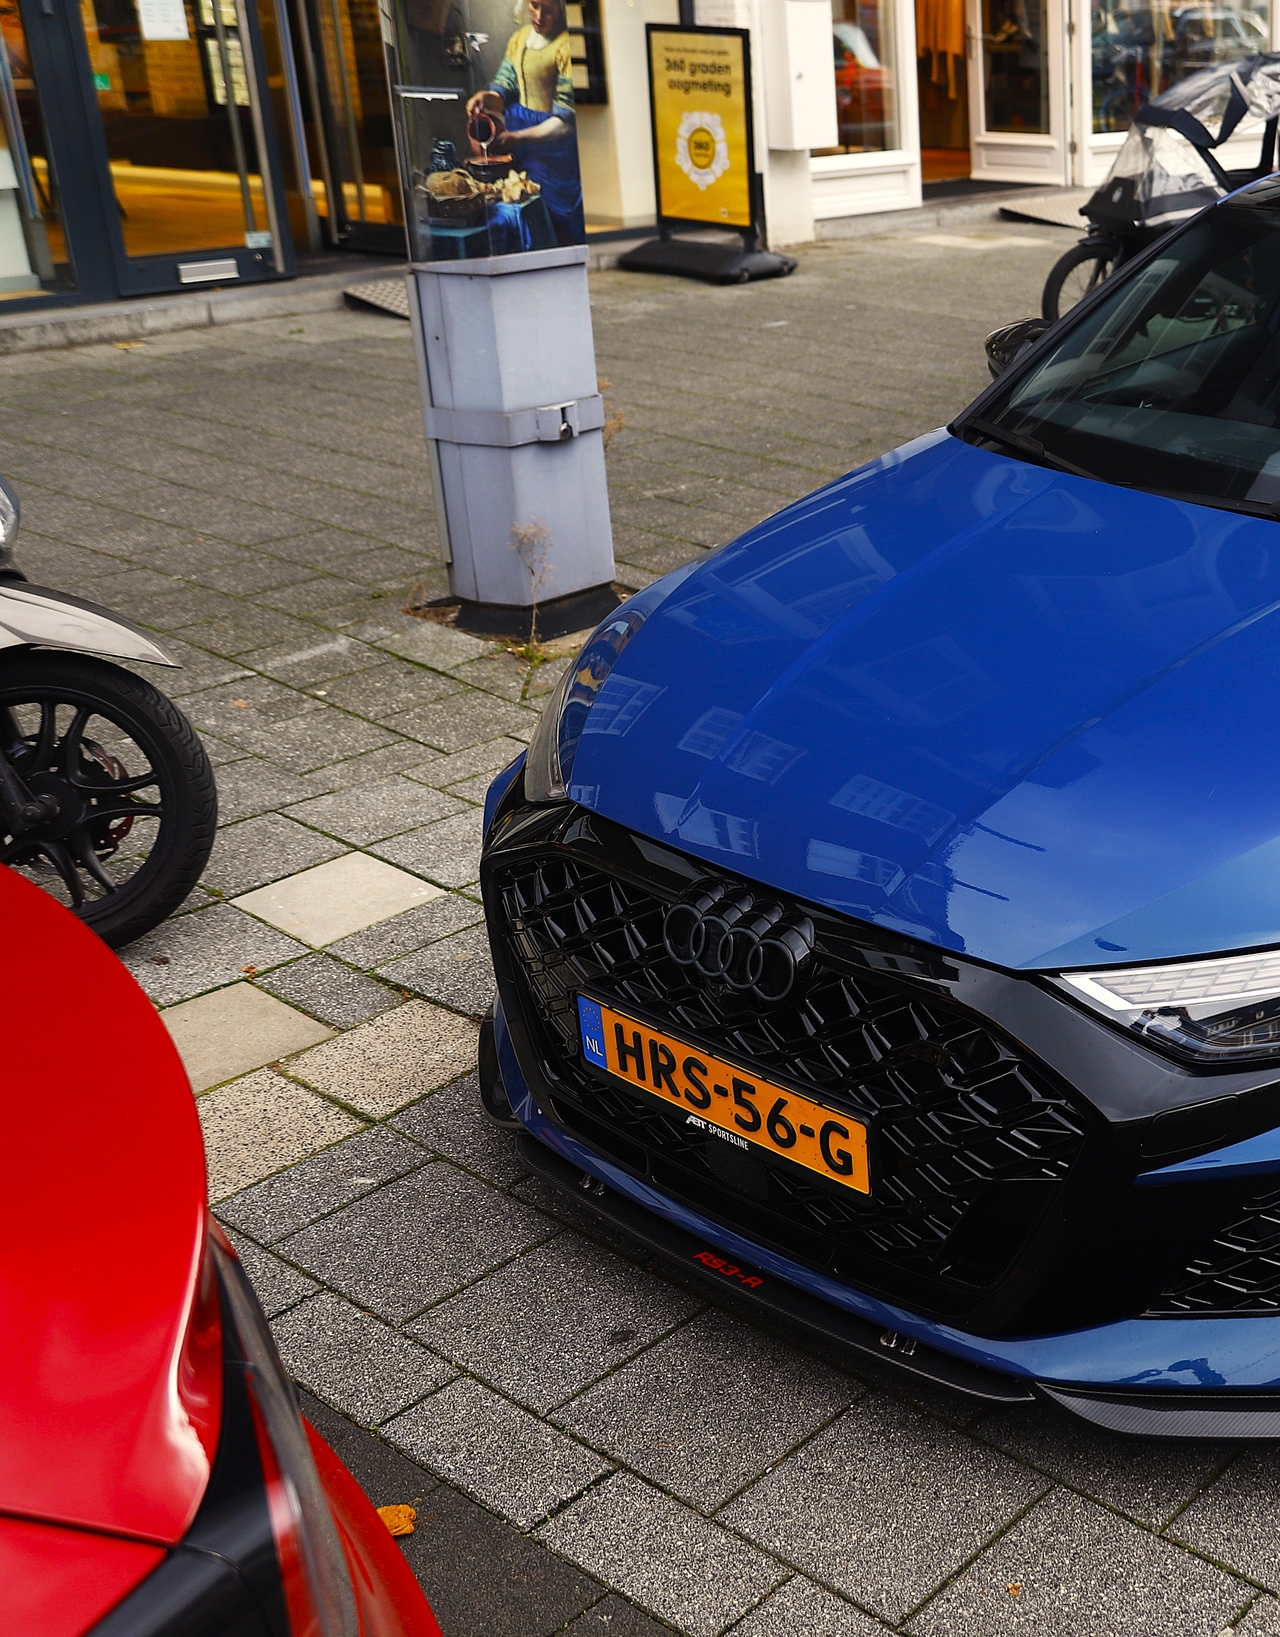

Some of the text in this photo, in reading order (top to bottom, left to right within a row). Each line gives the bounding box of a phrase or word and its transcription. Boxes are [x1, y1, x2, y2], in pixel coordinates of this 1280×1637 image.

[688, 61, 731, 77] graden
[667, 79, 732, 98] oogmeting
[585, 1034, 604, 1058] NL
[613, 1021, 854, 1177] HRS-56-G
[685, 1114, 750, 1151] ABT SPORTSLINE
[692, 1251, 765, 1289] RS3-R
